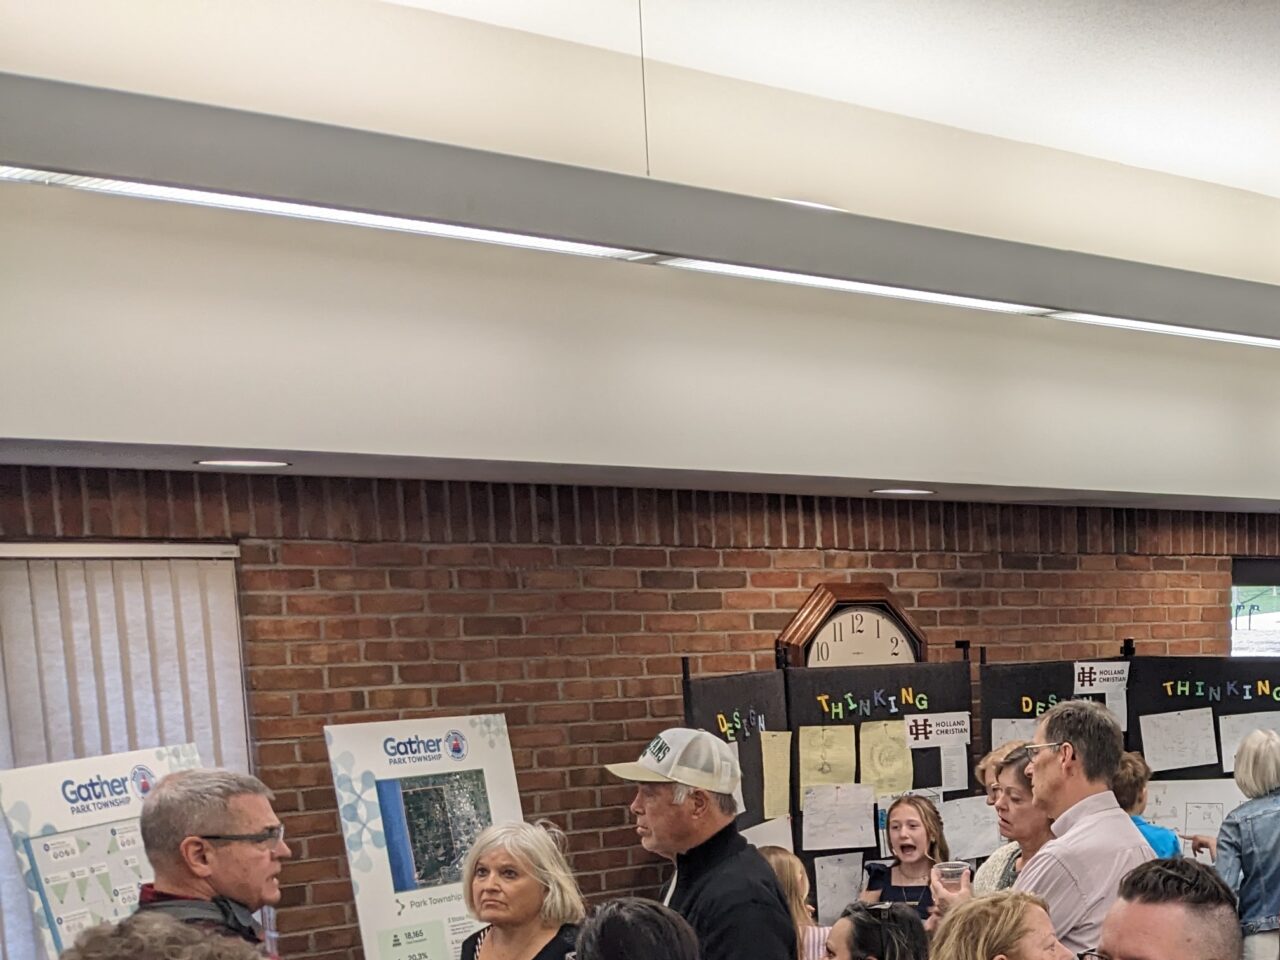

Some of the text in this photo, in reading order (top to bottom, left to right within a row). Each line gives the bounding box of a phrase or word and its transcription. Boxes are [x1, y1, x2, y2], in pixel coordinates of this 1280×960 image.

[833, 622, 843, 642] 11
[851, 613, 864, 634] 12
[876, 619, 880, 639] 1
[816, 641, 829, 661] 10
[890, 636, 899, 656] 2
[716, 687, 929, 741] DESIGN THINKING
[935, 720, 966, 728] HOLLAND
[935, 728, 968, 736] CHRISTIAN
[383, 734, 443, 757] Gather
[389, 754, 442, 766] PARK TOWNSHIP
[61, 774, 129, 805] Gather
[70, 796, 132, 815] PARK TOWNSHIP
[410, 892, 463, 908] Park Township
